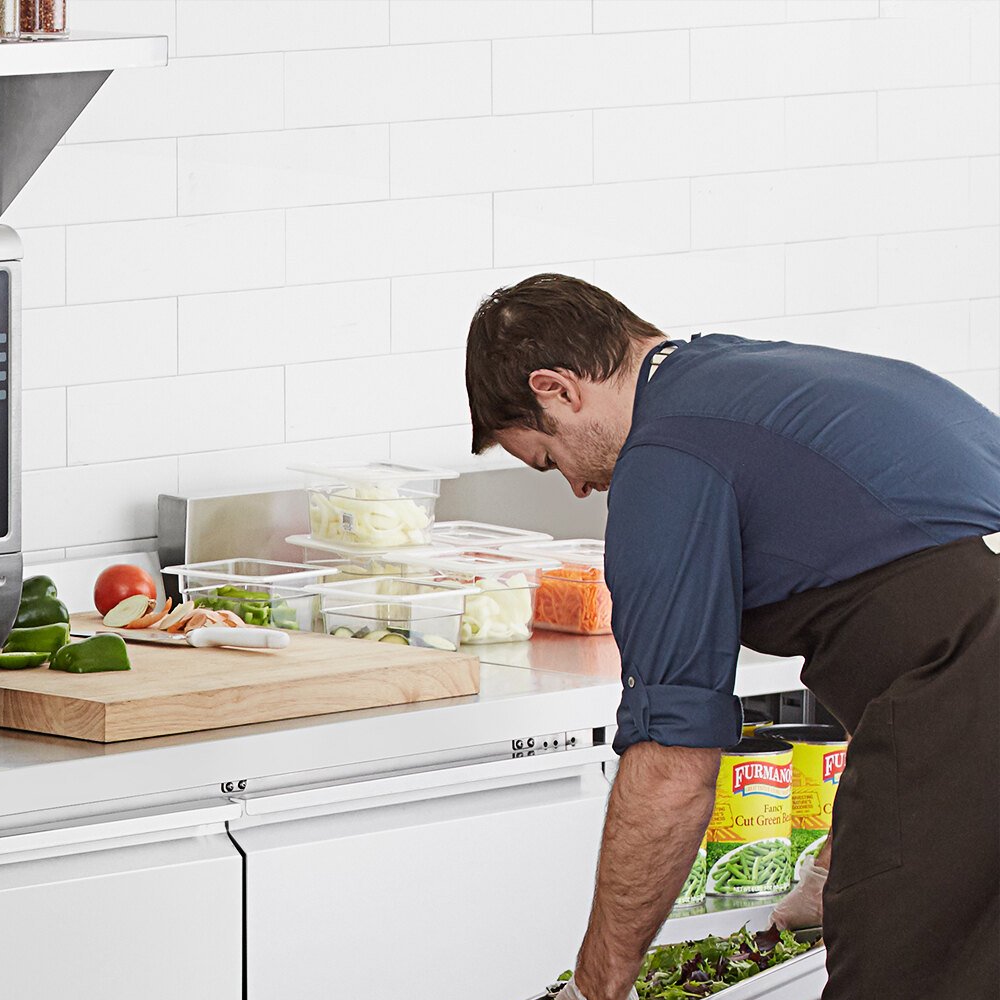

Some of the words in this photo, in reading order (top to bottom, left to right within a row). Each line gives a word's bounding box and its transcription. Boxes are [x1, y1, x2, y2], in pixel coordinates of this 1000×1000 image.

[764, 804, 783, 813] Fancy
[735, 815, 754, 826] Cut
[756, 815, 781, 826] Green
